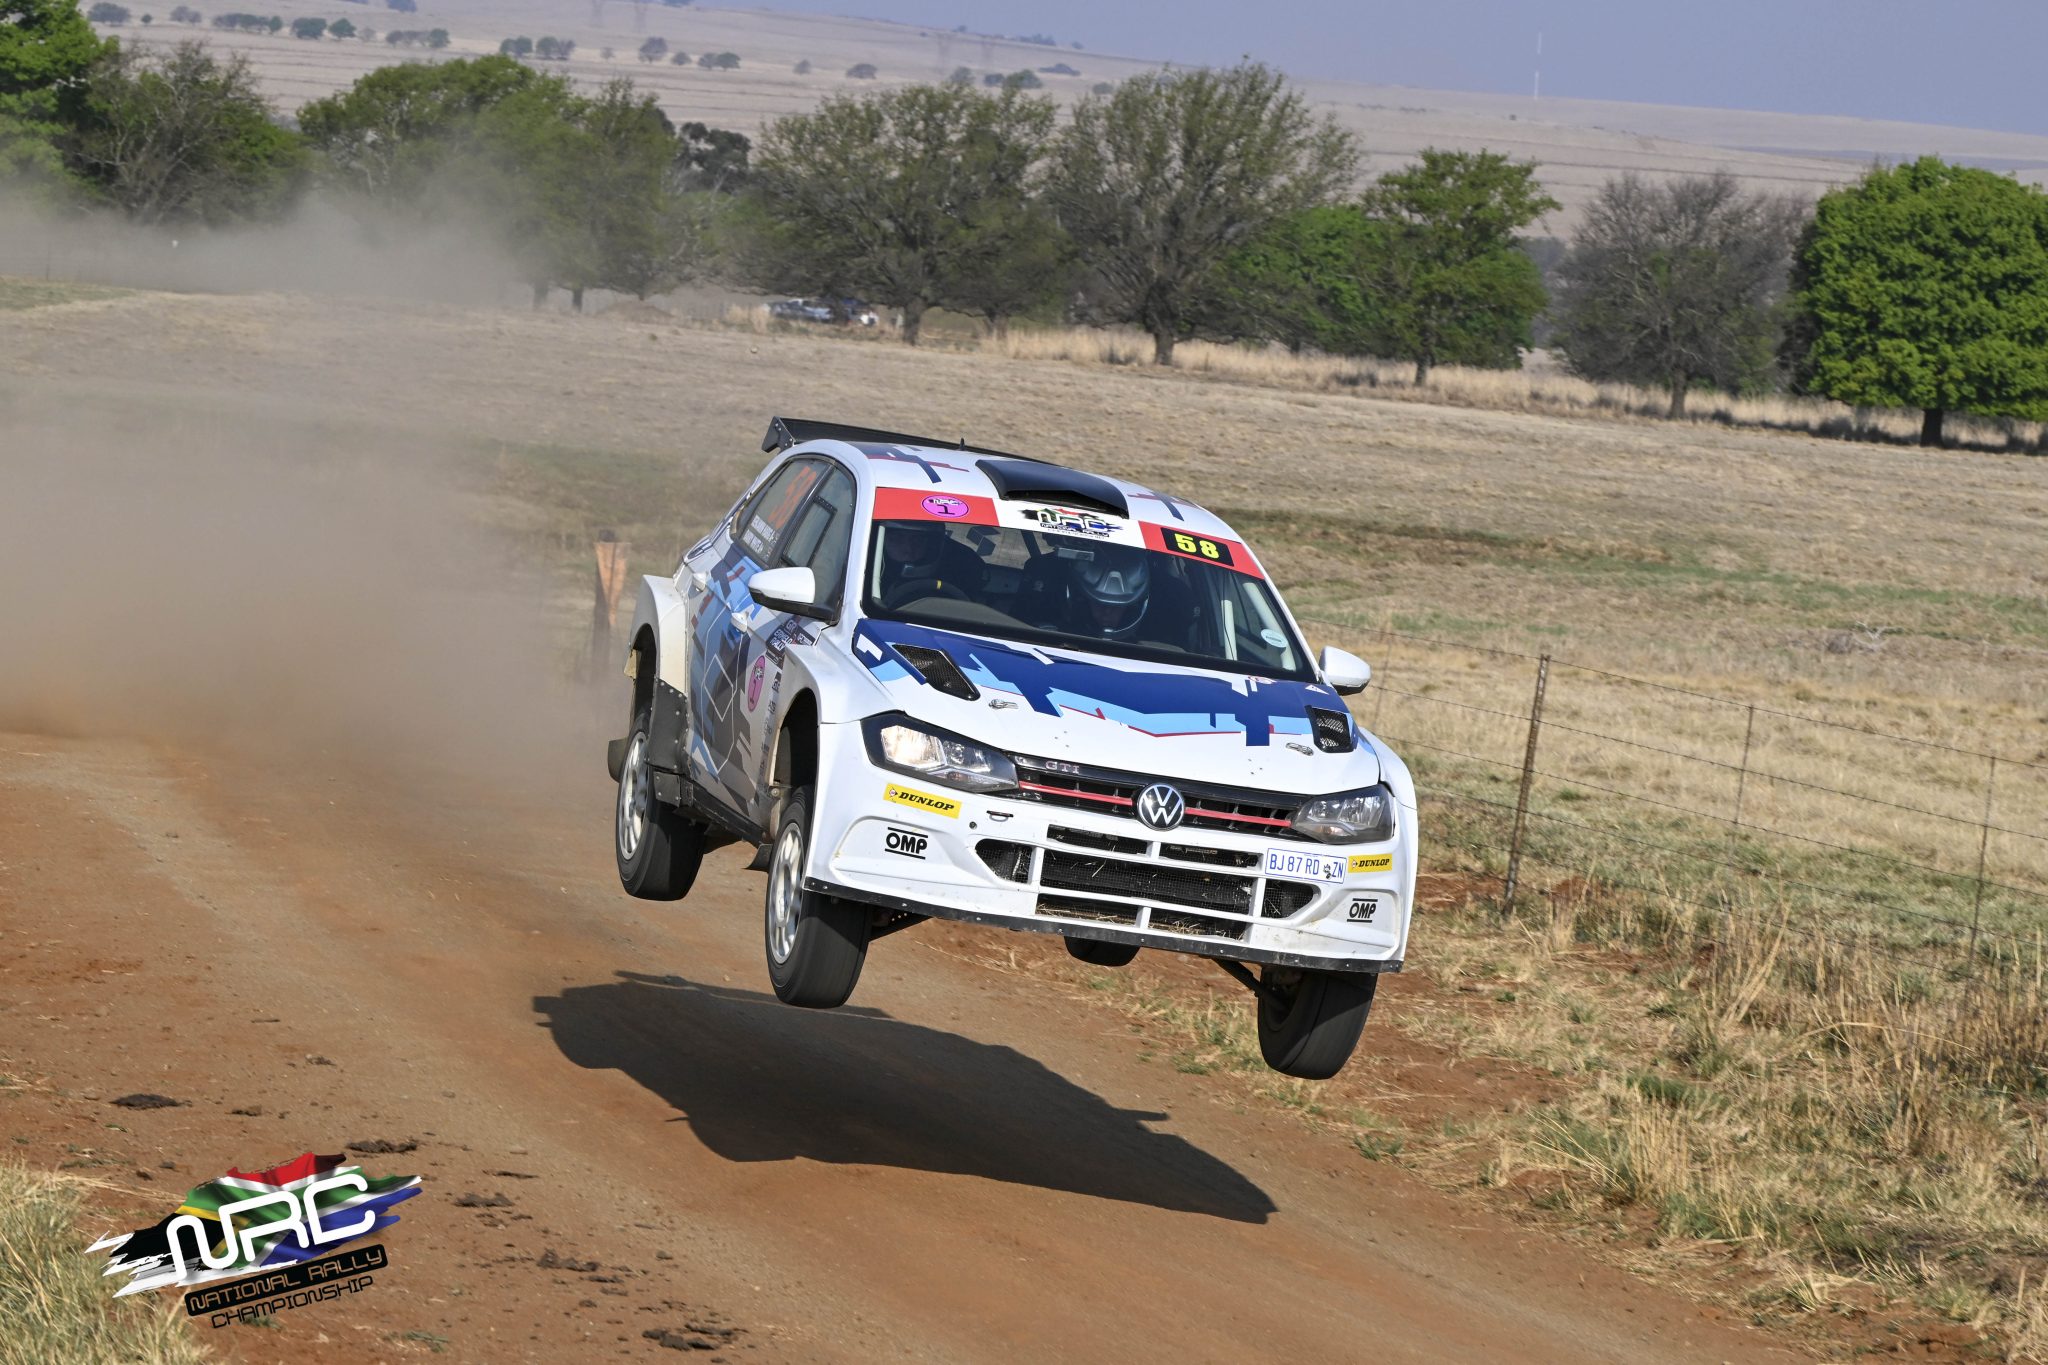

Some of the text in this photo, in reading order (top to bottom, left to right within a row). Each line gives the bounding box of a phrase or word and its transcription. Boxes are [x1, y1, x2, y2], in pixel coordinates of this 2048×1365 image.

[937, 504, 956, 515] 1
[1037, 511, 1109, 533] NRC
[1174, 533, 1220, 559] 58
[1045, 761, 1080, 774] GTI
[898, 791, 955, 812] DUNLOP
[885, 832, 928, 854] OMP
[1269, 853, 1344, 879] BJ 87 RD ZN
[1358, 858, 1390, 868] DUNLOP
[1349, 902, 1377, 919] OMP
